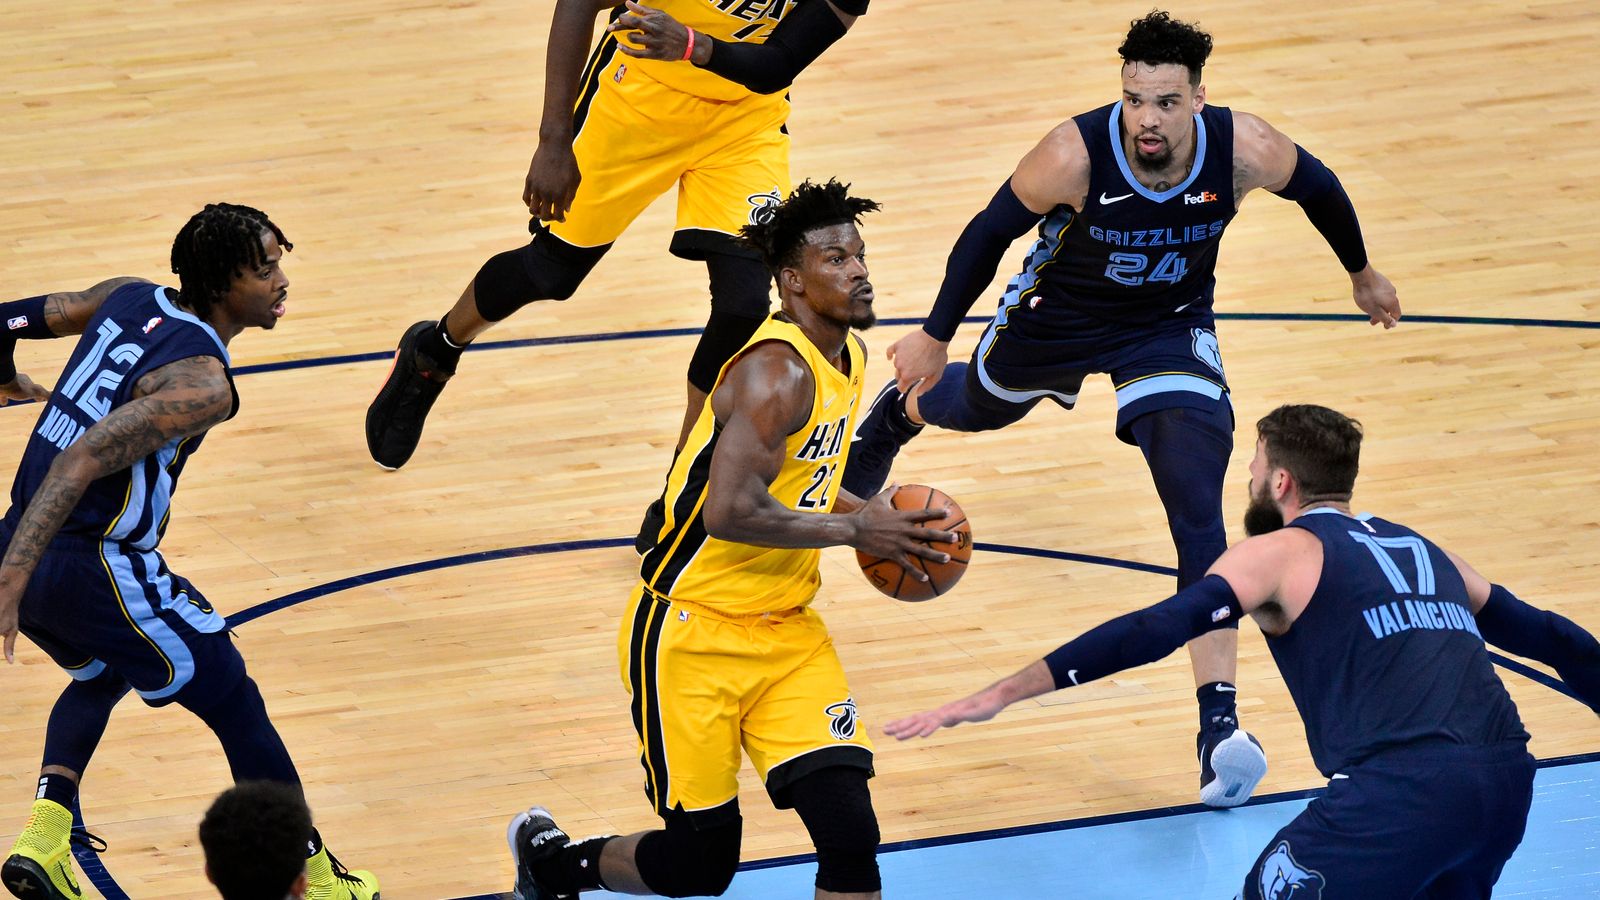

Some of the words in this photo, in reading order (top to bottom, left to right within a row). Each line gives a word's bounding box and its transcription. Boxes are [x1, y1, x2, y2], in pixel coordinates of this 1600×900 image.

[1184, 191, 1218, 205] FedEx
[1088, 219, 1224, 247] GRIZZLIES
[1103, 251, 1190, 287] 24
[60, 317, 145, 423] 12
[795, 414, 851, 461] HA
[1347, 530, 1436, 596] 17
